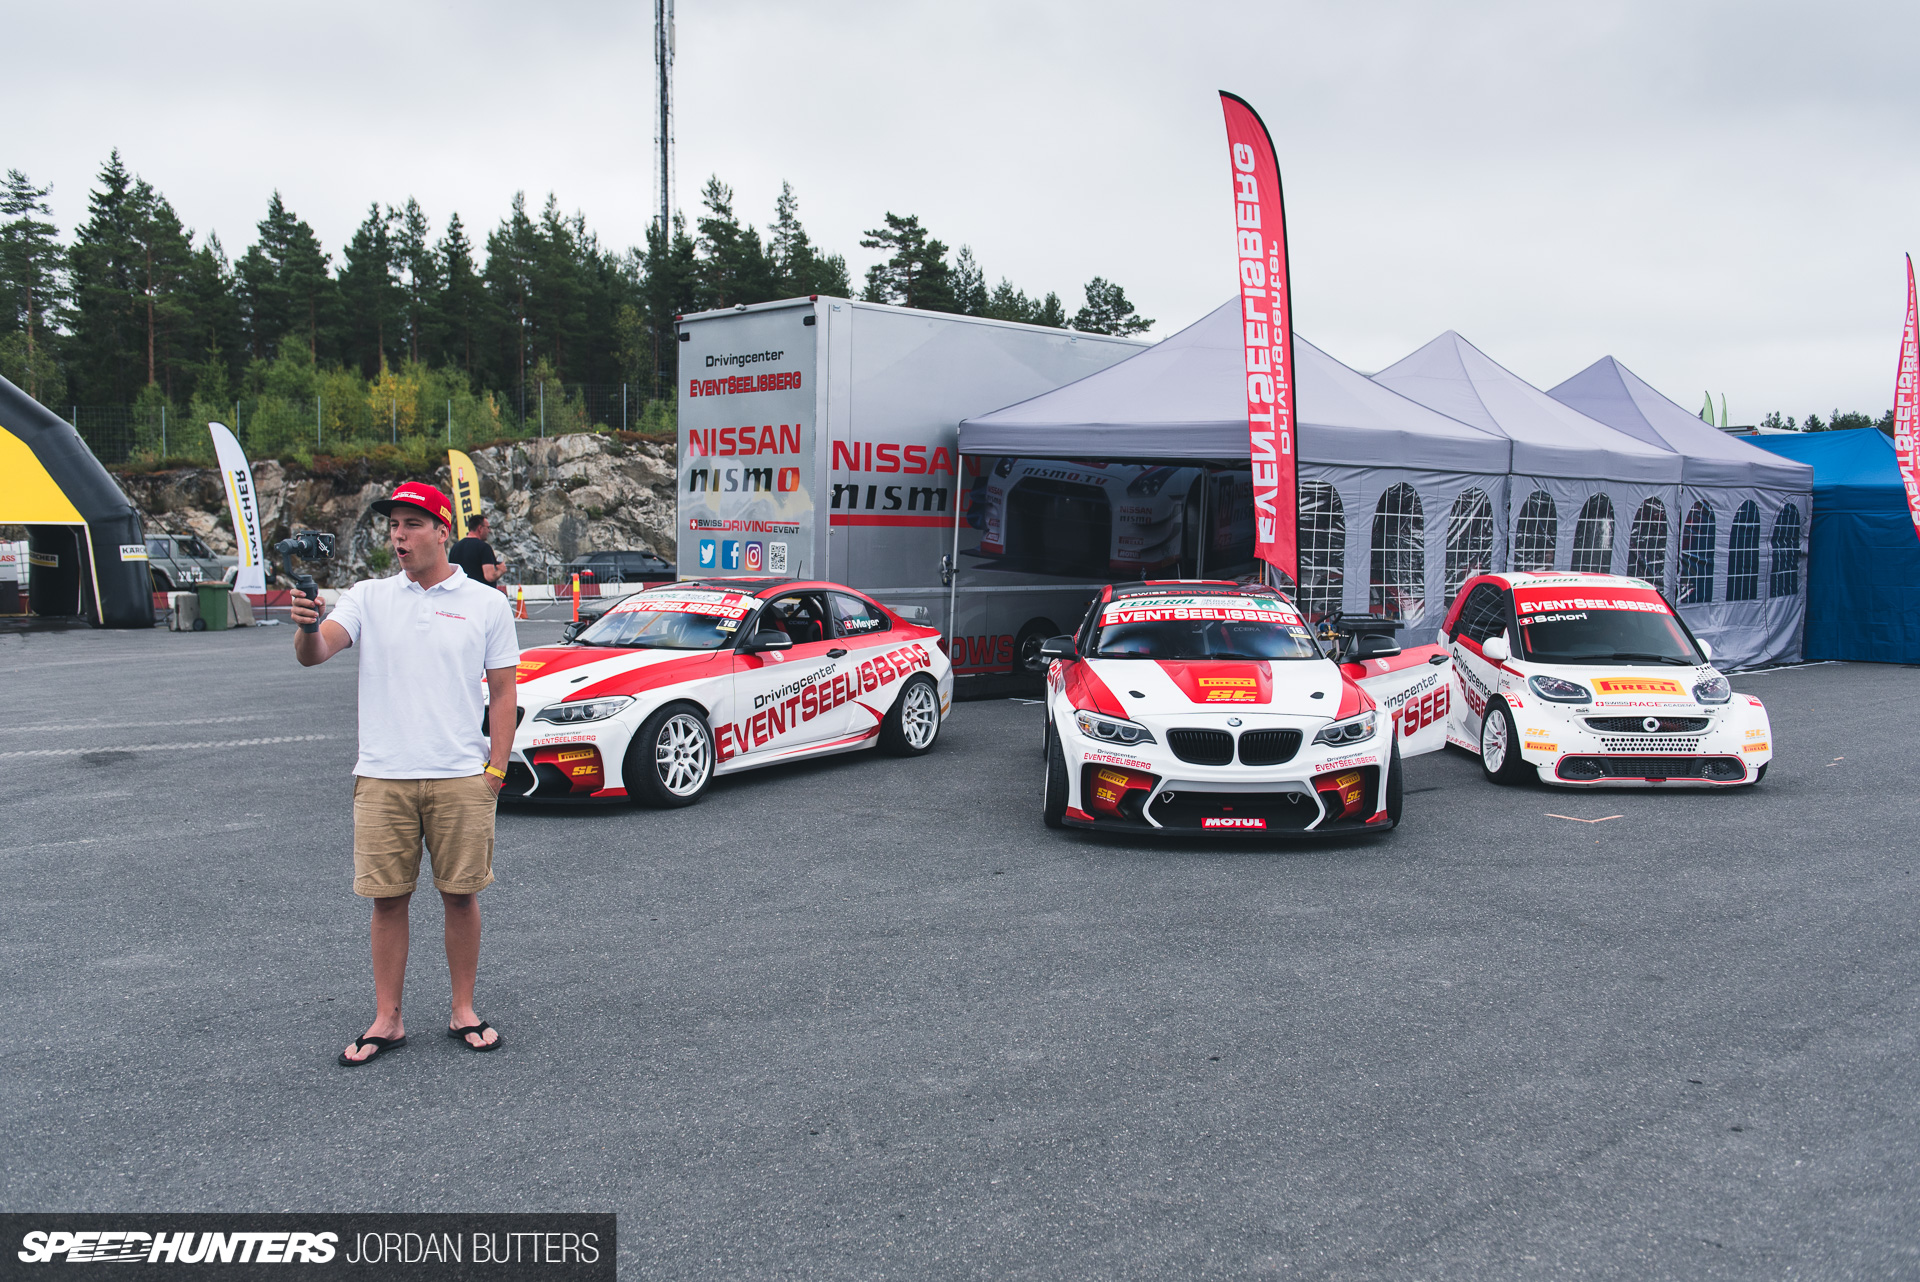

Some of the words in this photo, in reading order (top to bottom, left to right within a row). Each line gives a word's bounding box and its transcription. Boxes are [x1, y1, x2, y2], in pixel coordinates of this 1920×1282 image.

[705, 350, 784, 368] Drivingcenter
[689, 371, 801, 397] EVENTSEELISBERG
[689, 424, 801, 457] NISSAN
[832, 440, 981, 477] NISSAN
[689, 467, 800, 492] nismo
[1119, 505, 1153, 515] NISSAN
[723, 520, 773, 533] DRIVING
[773, 525, 800, 534] EVENT
[1119, 598, 1197, 608] FEDERAL
[1520, 598, 1668, 614] EVENTSEELISBERG
[851, 617, 880, 630] Meyer
[1105, 609, 1298, 624] EVENTSEELISBERG
[947, 634, 1015, 667] OWS
[1453, 647, 1492, 699] Drivingcente
[754, 663, 837, 710] Drivingcenter
[1384, 672, 1438, 709] ingcenter
[1600, 681, 1678, 692] PIRELLI
[714, 643, 932, 764] EVENTSEELISBERG
[532, 735, 596, 745] EVENTSEELISBERG
[1083, 752, 1152, 770] EVENTSEELISBERG
[1097, 749, 1137, 759] Drivingcenter
[1315, 755, 1377, 772] EVENTSEELISBERG
[1204, 818, 1263, 827] MOTUL
